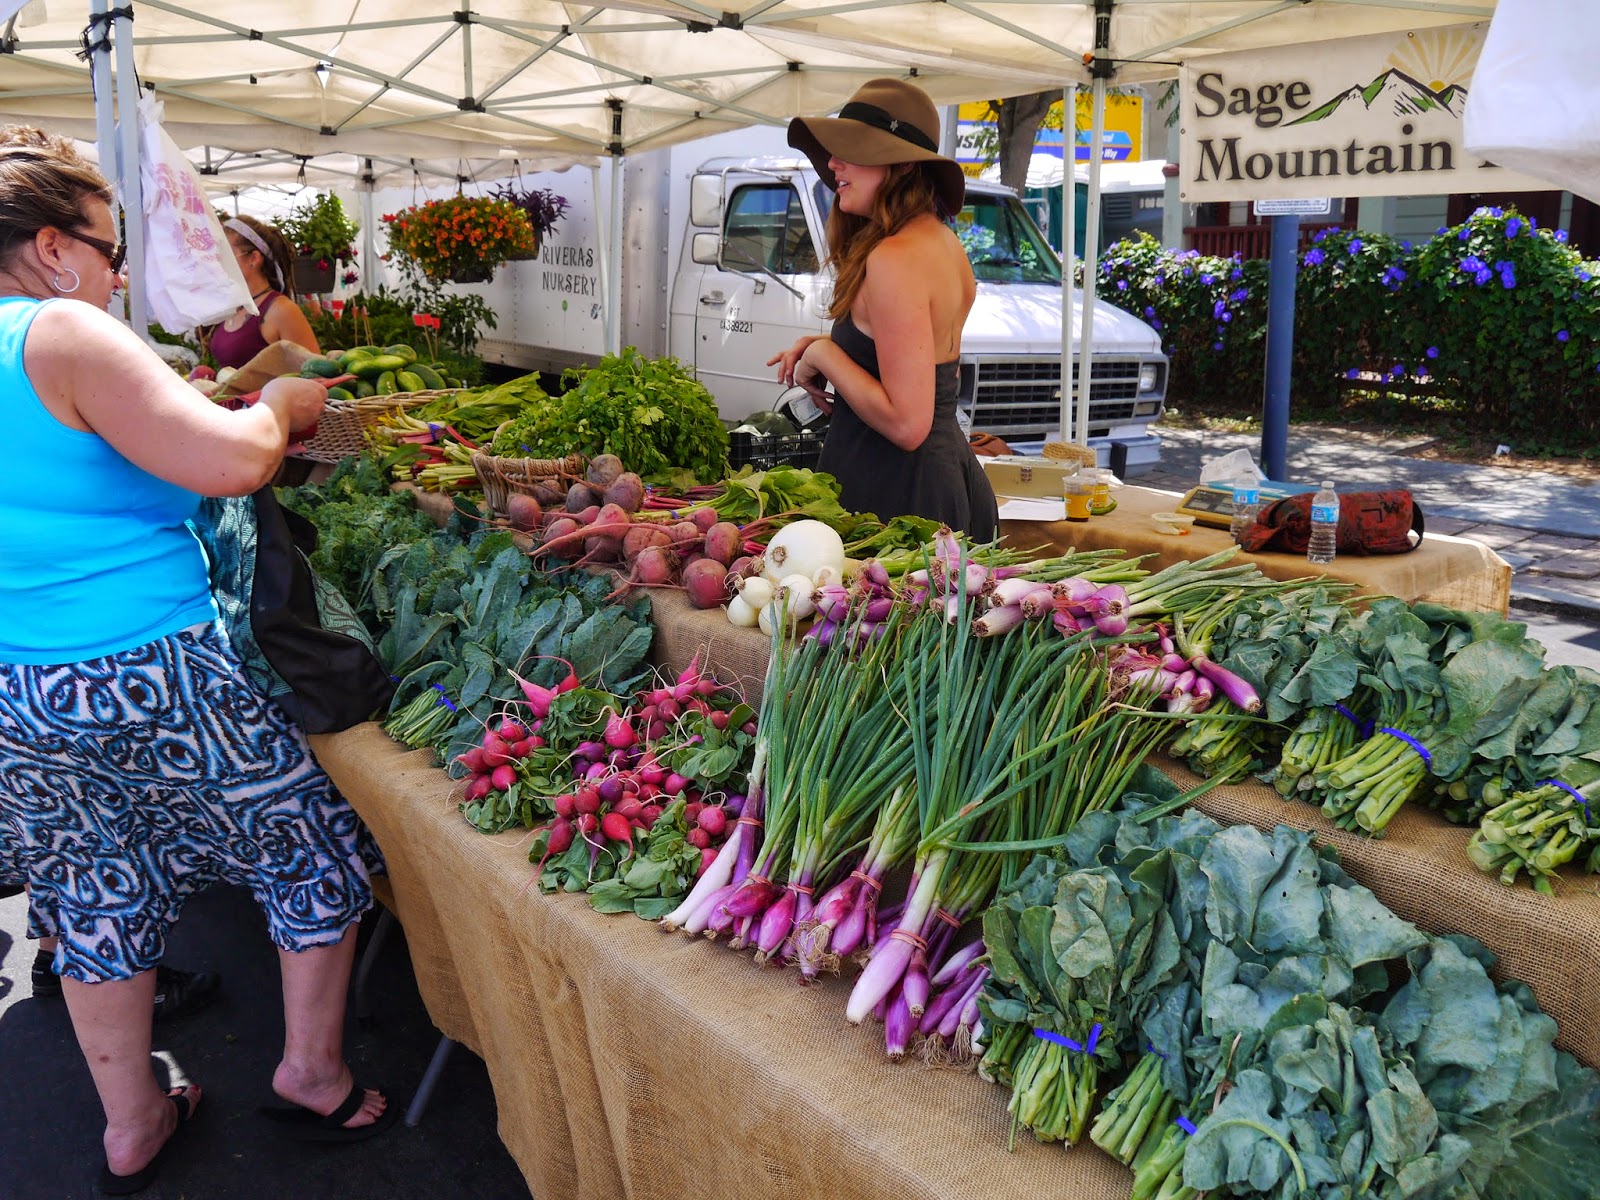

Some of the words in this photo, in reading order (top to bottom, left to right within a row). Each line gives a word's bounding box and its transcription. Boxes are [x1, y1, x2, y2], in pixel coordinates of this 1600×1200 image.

[1196, 73, 1311, 128] Sage
[1194, 124, 1456, 182] Mountain
[542, 245, 594, 268] RIVERAS
[542, 271, 597, 297] NURSERY
